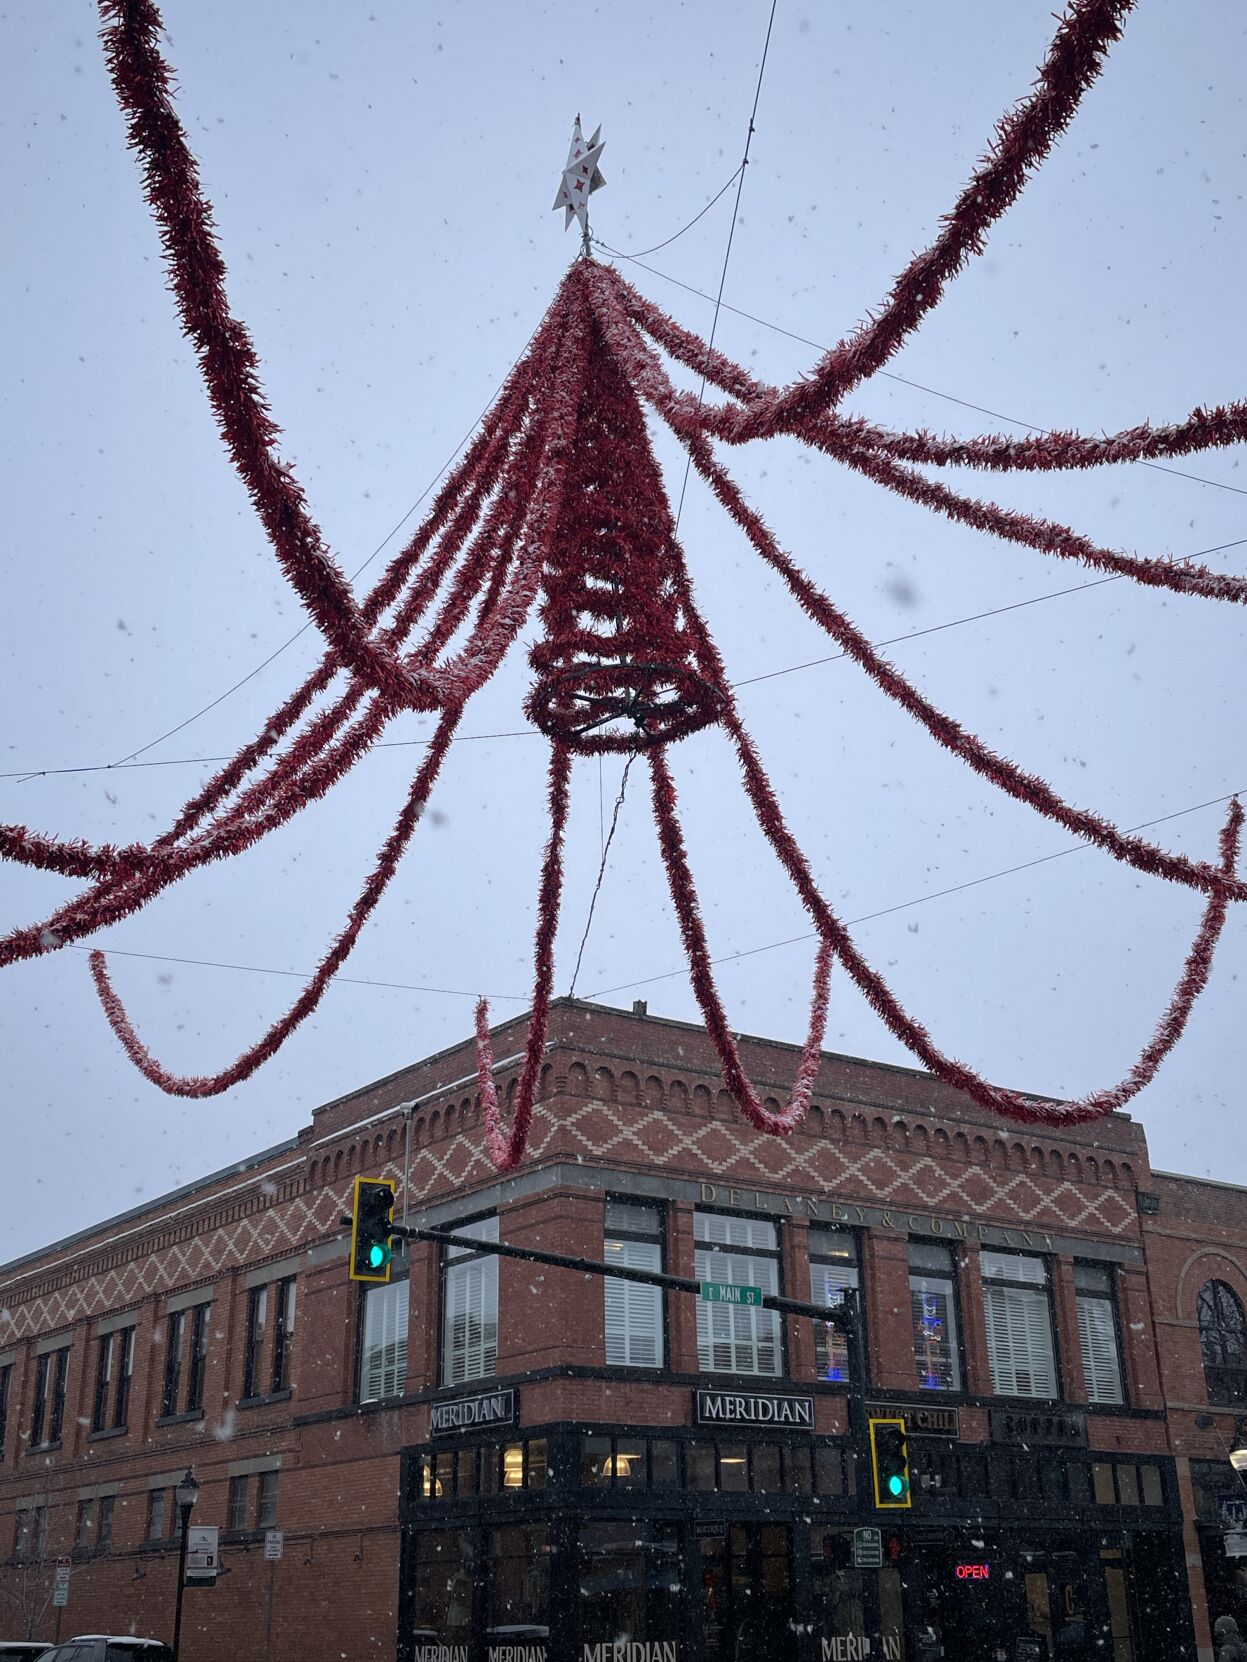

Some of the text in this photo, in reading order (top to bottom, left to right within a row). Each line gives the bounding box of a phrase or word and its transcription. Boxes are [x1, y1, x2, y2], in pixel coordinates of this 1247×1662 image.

[701, 1183, 1054, 1250] DELANEY & COMPANY
[709, 1285, 755, 1304] E MAIN ST
[432, 1396, 506, 1429] MERIDIAN
[704, 1395, 810, 1423] MERIDIAN
[956, 1565, 989, 1579] OPEN
[415, 1645, 469, 1662] MERIDIAN
[488, 1646, 548, 1662] MERIDIAN
[582, 1640, 678, 1662] MERIDIAN
